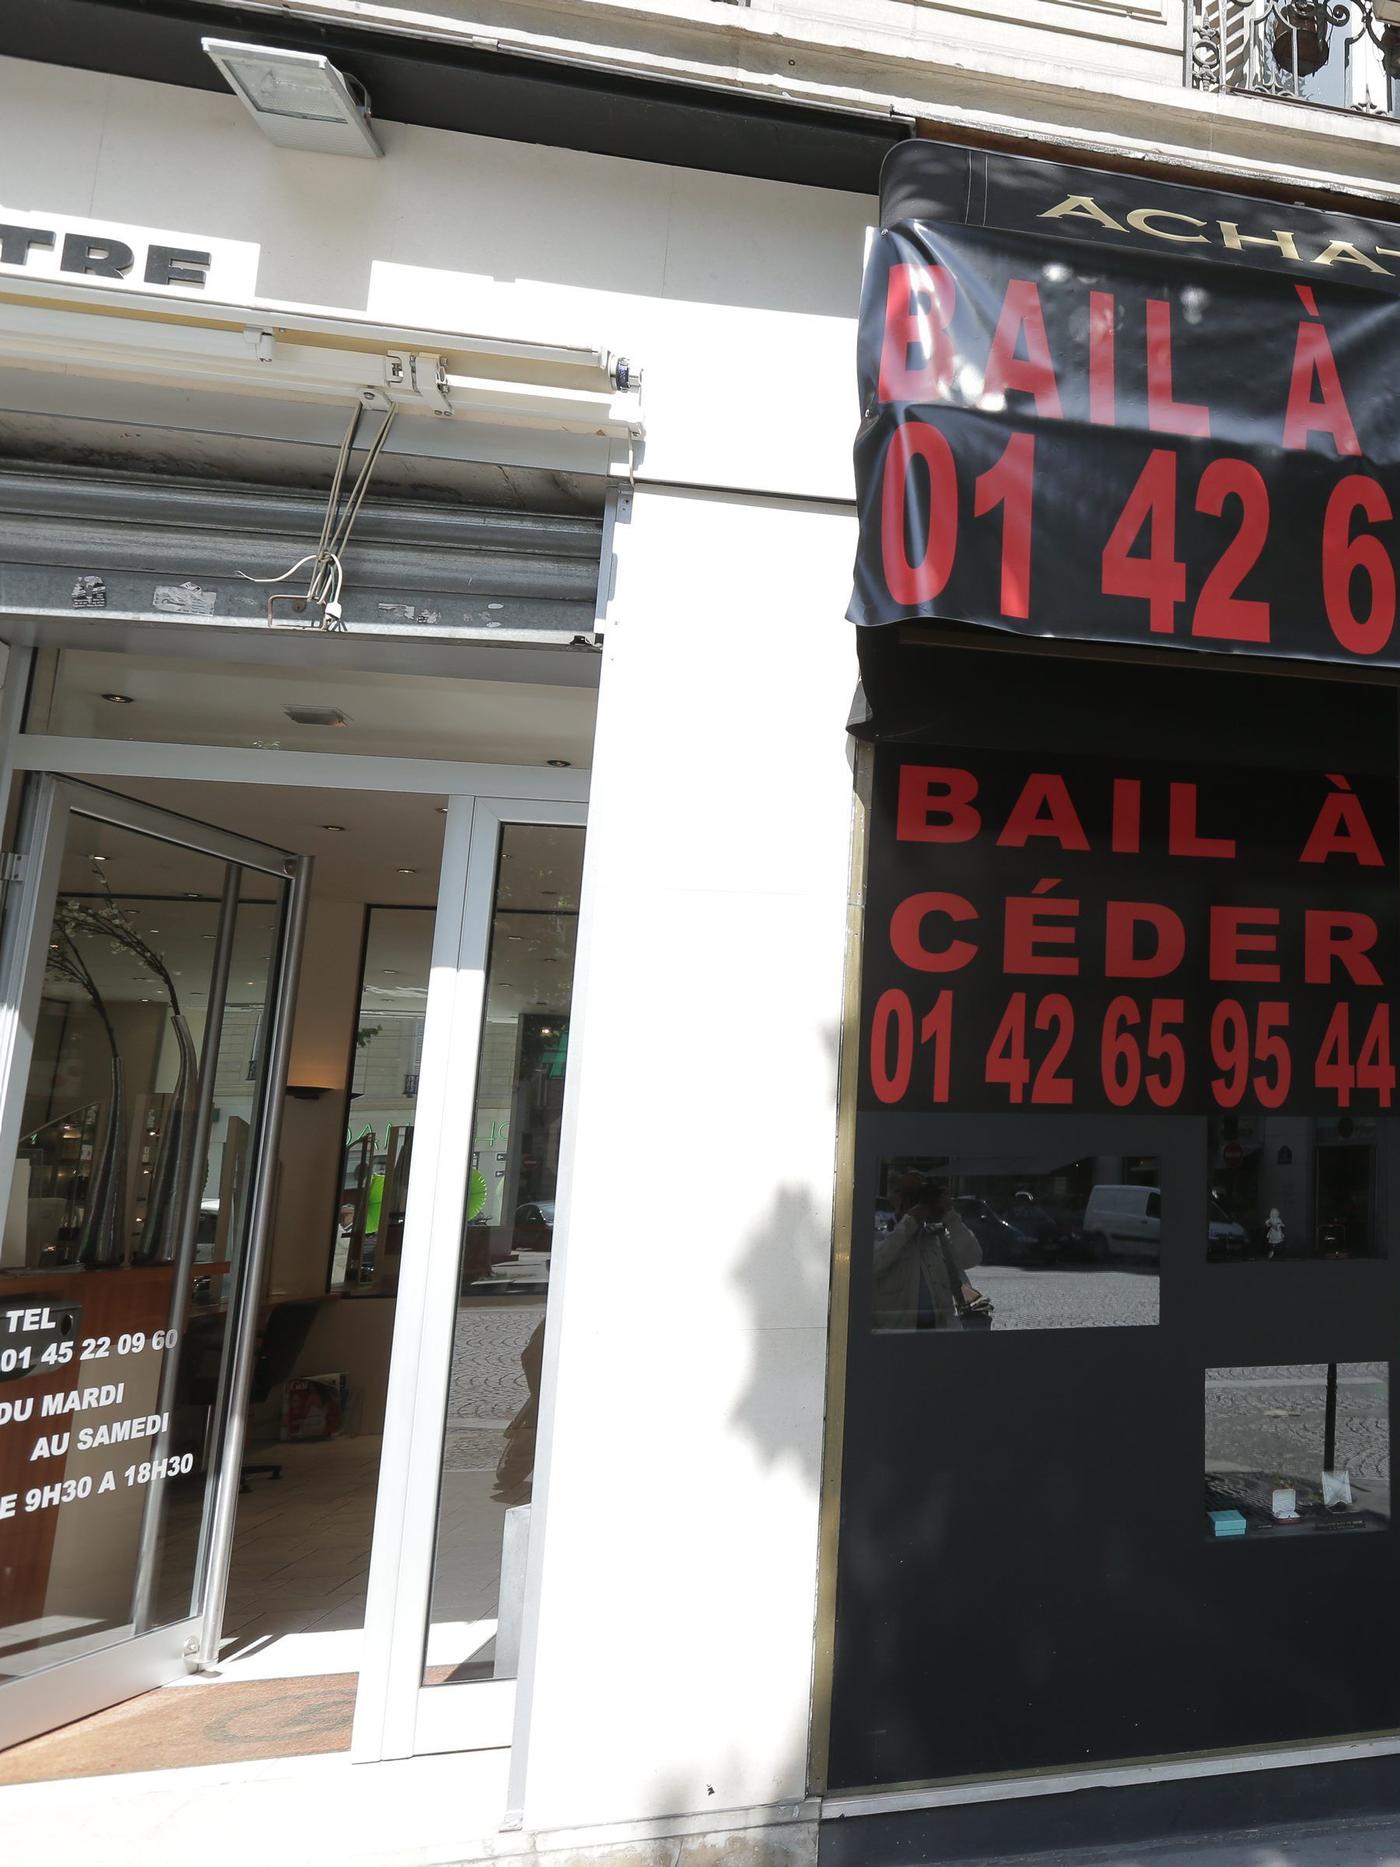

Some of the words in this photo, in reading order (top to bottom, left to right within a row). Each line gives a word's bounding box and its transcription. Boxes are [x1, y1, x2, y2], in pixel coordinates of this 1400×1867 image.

[876, 262, 1209, 437] BAIL
[1281, 284, 1363, 457] À
[881, 420, 1035, 621] 01
[1100, 448, 1272, 644] 42
[895, 764, 1237, 859] BAIL
[1299, 774, 1386, 867] À
[888, 877, 1385, 987] CÉDER
[869, 988, 954, 1105] 01
[984, 991, 1075, 1105] 42
[1101, 995, 1186, 1108] 65
[1209, 998, 1292, 1109] 95
[1314, 1001, 1397, 1109] 44
[0, 1346, 32, 1373] 01
[41, 1341, 74, 1365] 45
[79, 1336, 111, 1361] 22
[117, 1332, 146, 1355] 09
[152, 1328, 178, 1351] 60
[6, 1307, 56, 1333] TEL
[30, 1431, 71, 1462] AU
[77, 1412, 170, 1451] SAMEDI
[41, 1382, 125, 1417] MARDI
[24, 1475, 93, 1513] 9H30
[97, 1470, 117, 1495] A
[124, 1452, 194, 1487] 18H30
